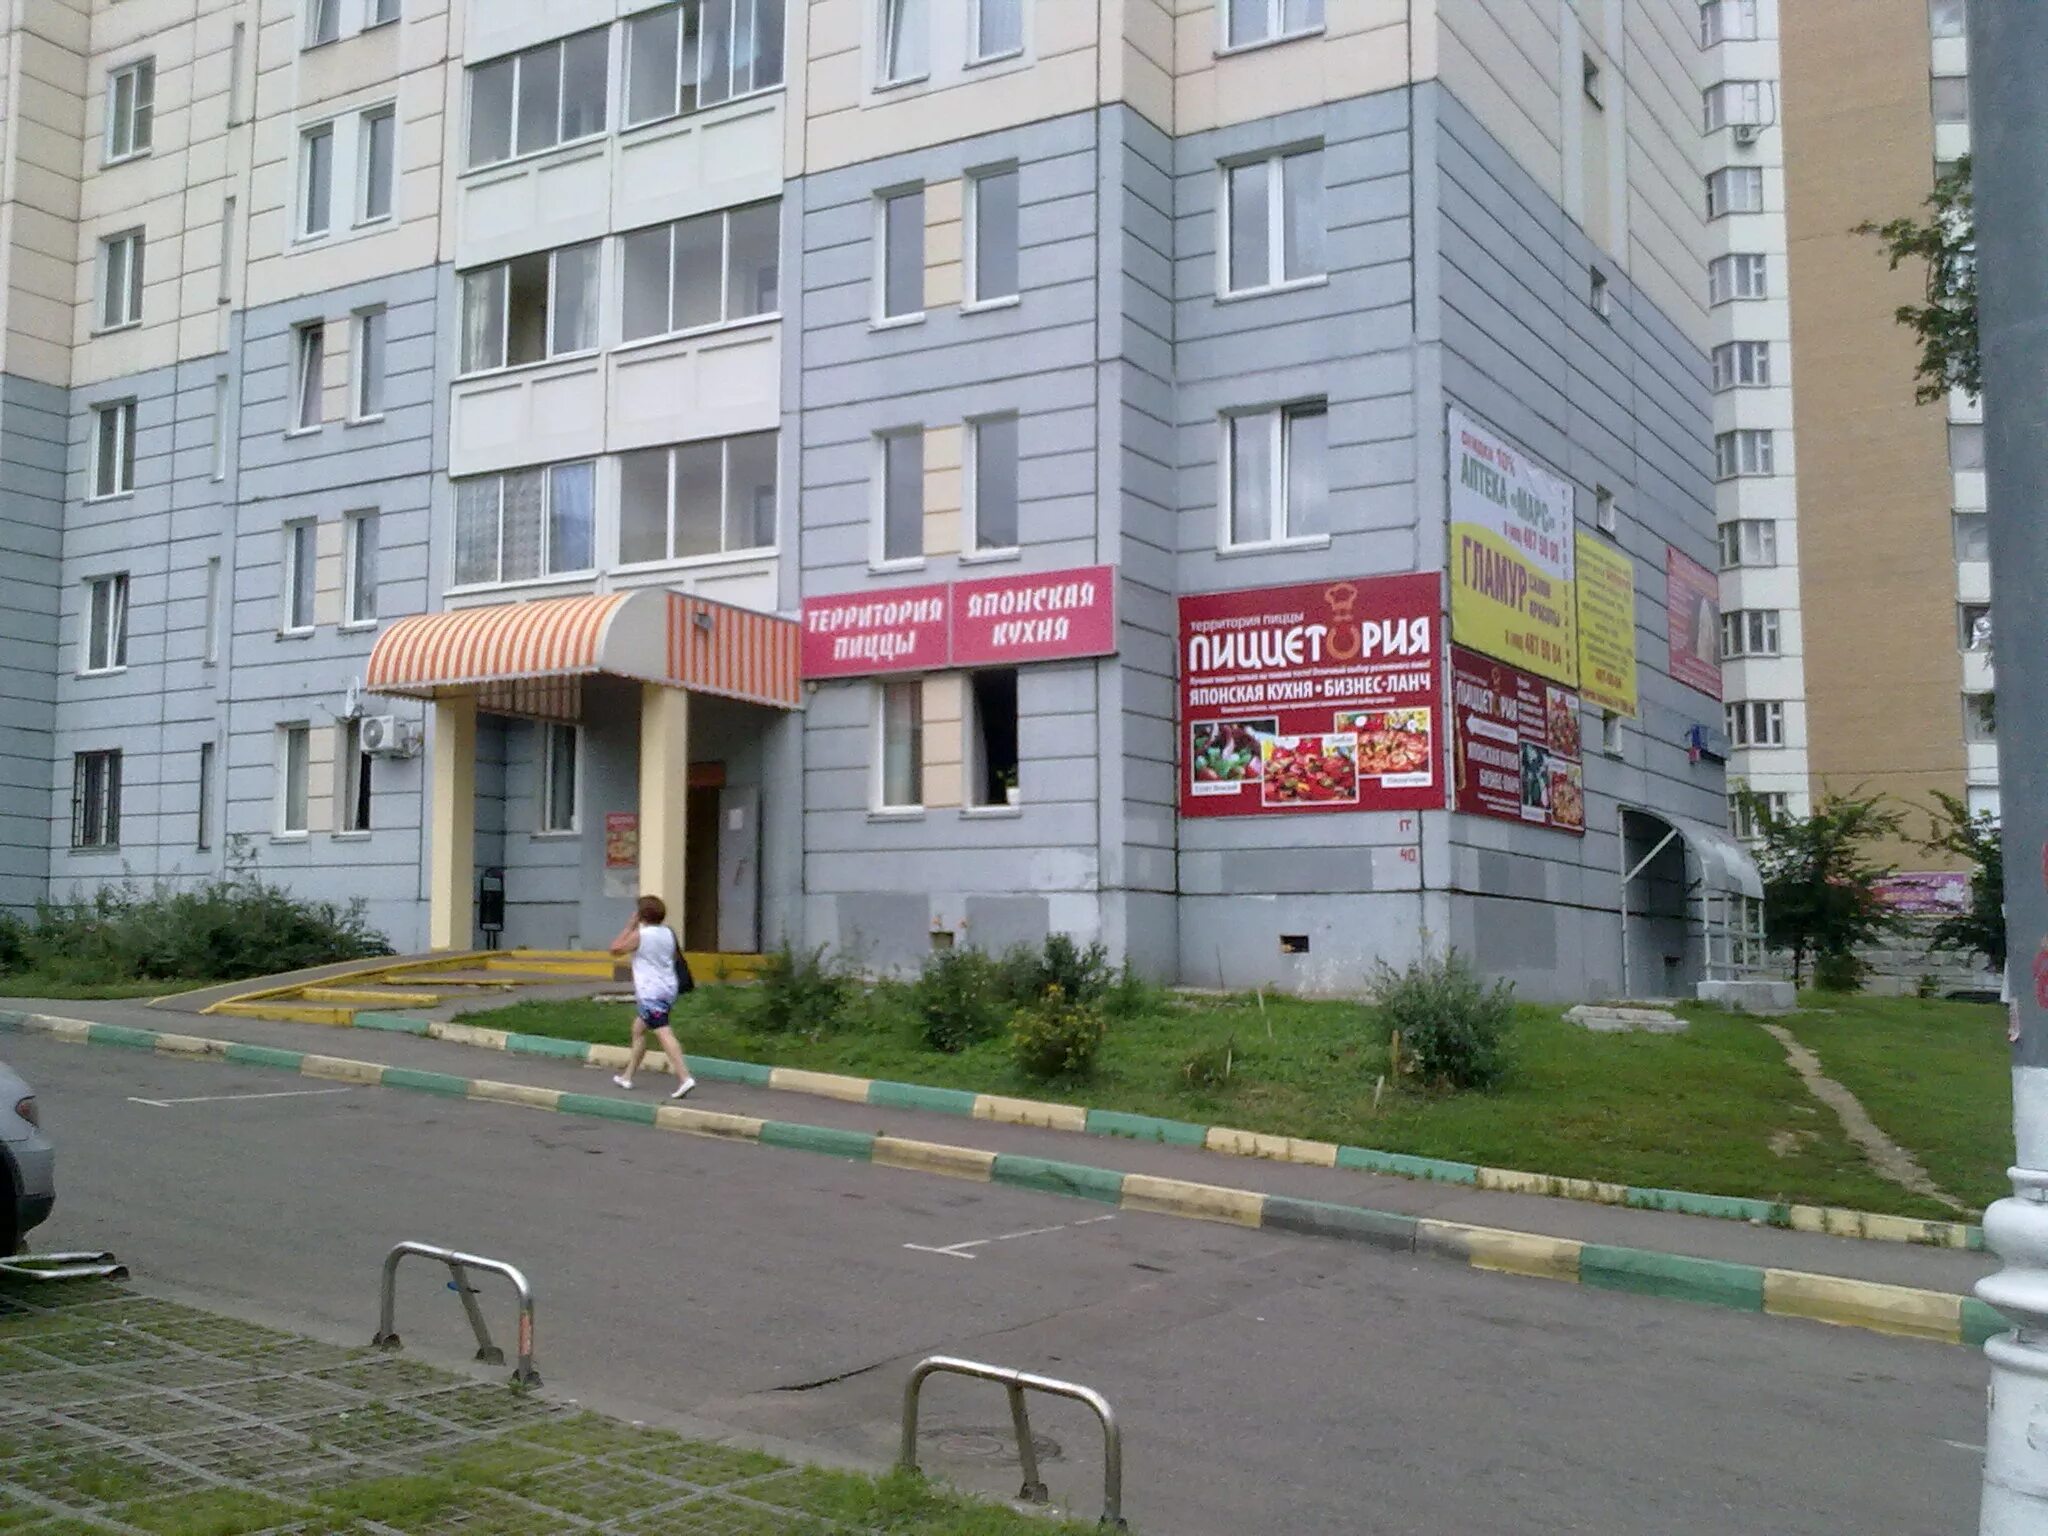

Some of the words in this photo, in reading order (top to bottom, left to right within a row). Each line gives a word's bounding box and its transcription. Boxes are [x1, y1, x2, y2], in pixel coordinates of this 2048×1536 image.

[1460, 453, 1508, 509] АПТЕКА
[1461, 535, 1527, 613] ГЛАМУР
[807, 597, 943, 633] ТЕРРИТОРИЯ
[967, 581, 1095, 618] ЯПОНСКАЯ
[991, 616, 1070, 647] КУХНЯ
[1190, 615, 1260, 633] территория
[1263, 612, 1304, 627] пиццы
[833, 631, 916, 662] ПИЦЦЫ
[1189, 684, 1264, 706] ЯПОНСКАЯ
[1267, 680, 1313, 700] КУХНЯ
